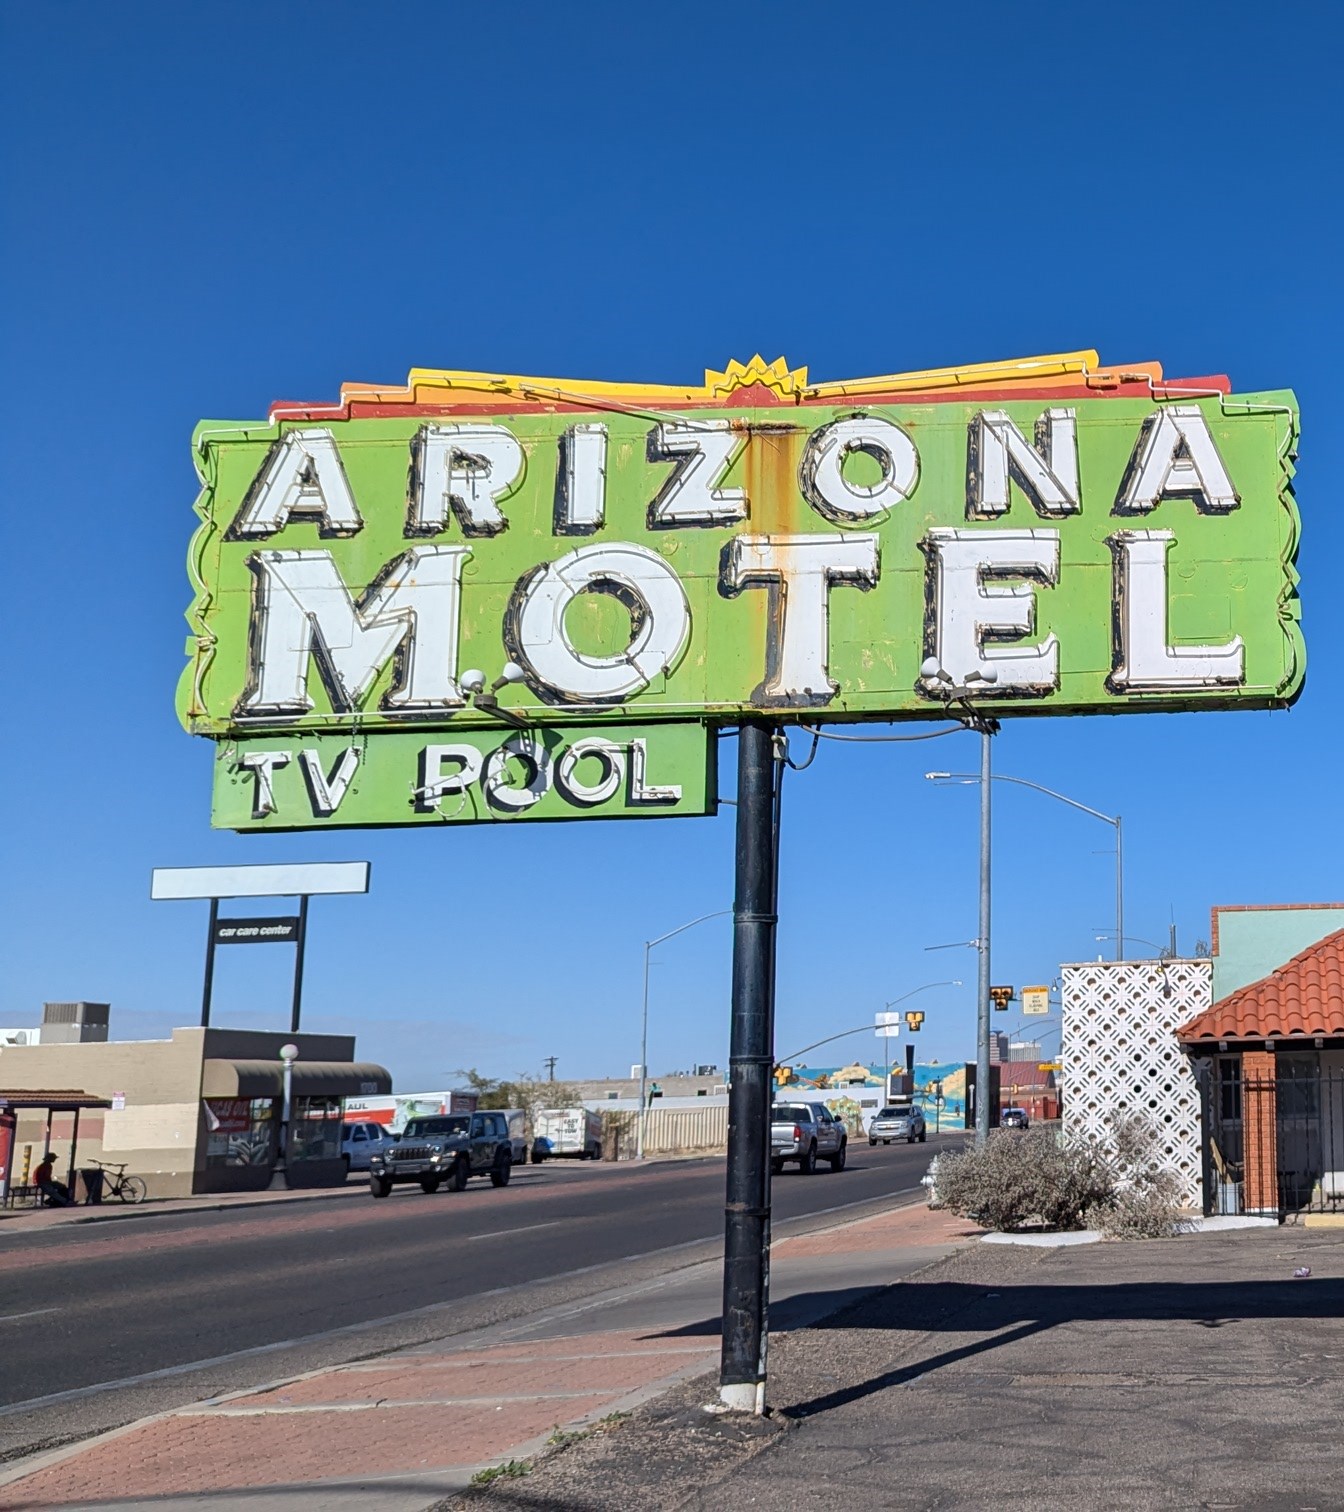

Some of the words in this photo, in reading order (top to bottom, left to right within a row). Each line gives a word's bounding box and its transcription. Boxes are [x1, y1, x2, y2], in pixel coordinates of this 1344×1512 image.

[226, 405, 1242, 539] ARIZONA
[233, 528, 1247, 716] MOTEL
[238, 747, 362, 818] TV
[414, 736, 683, 812] POOL
[219, 928, 236, 937] car
[236, 927, 259, 936] care
[260, 925, 293, 935] center
